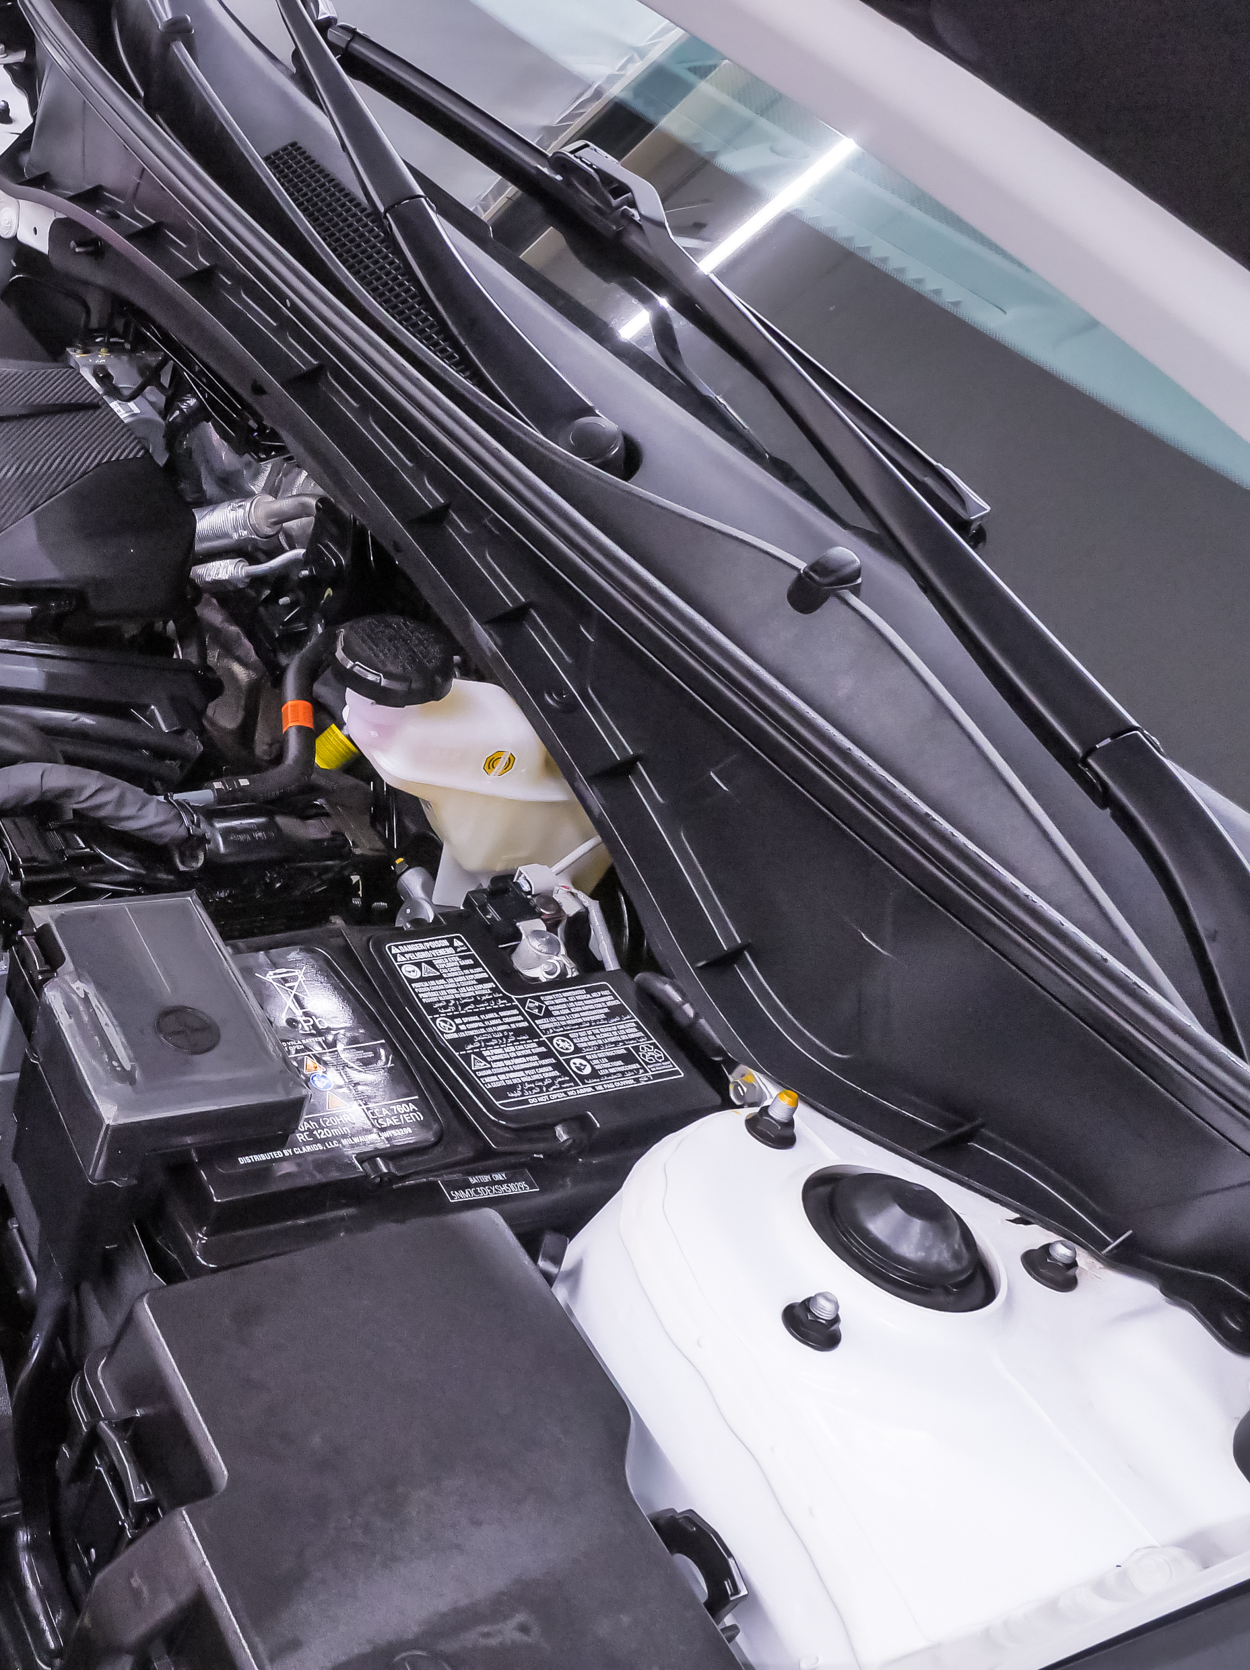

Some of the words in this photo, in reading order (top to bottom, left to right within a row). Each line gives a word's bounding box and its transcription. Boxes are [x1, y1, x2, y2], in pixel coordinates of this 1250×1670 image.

[398, 939, 450, 952] DANGER/POISON
[404, 947, 456, 960] PELIGRO/VENENO
[369, 1108, 390, 1119] CCA
[390, 1102, 418, 1114] 760A
[296, 1130, 313, 1142] RC
[313, 1126, 350, 1139] 120min
[238, 1150, 283, 1164] DISTRIBUTED
[284, 1148, 294, 1157] BY
[469, 1174, 492, 1184] BATTERY
[492, 1172, 507, 1181] ONLY
